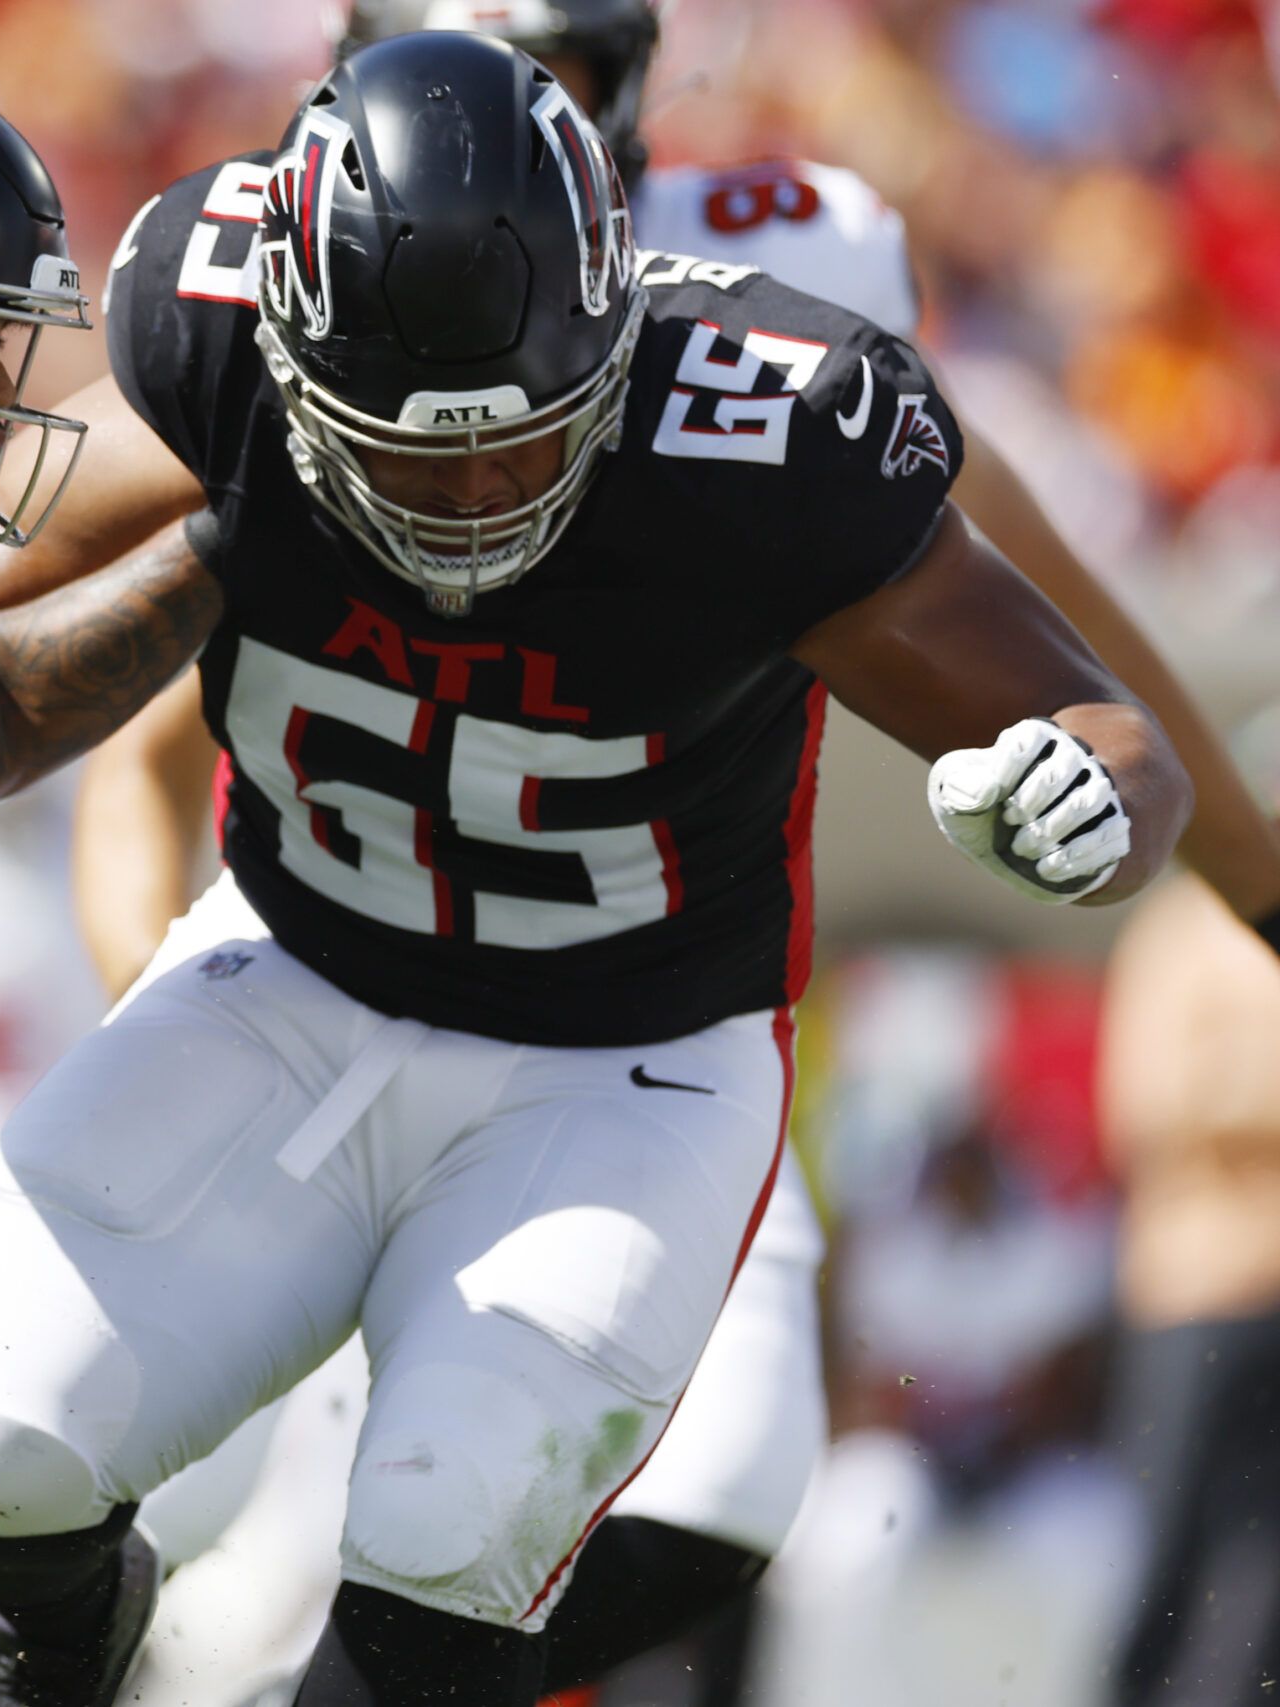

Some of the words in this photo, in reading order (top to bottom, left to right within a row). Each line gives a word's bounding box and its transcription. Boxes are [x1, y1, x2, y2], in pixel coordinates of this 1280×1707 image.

[433, 404, 498, 425] ATL
[652, 318, 829, 465] 65
[321, 596, 590, 724] ATL
[429, 591, 468, 614] NFL
[225, 634, 684, 951] 65
